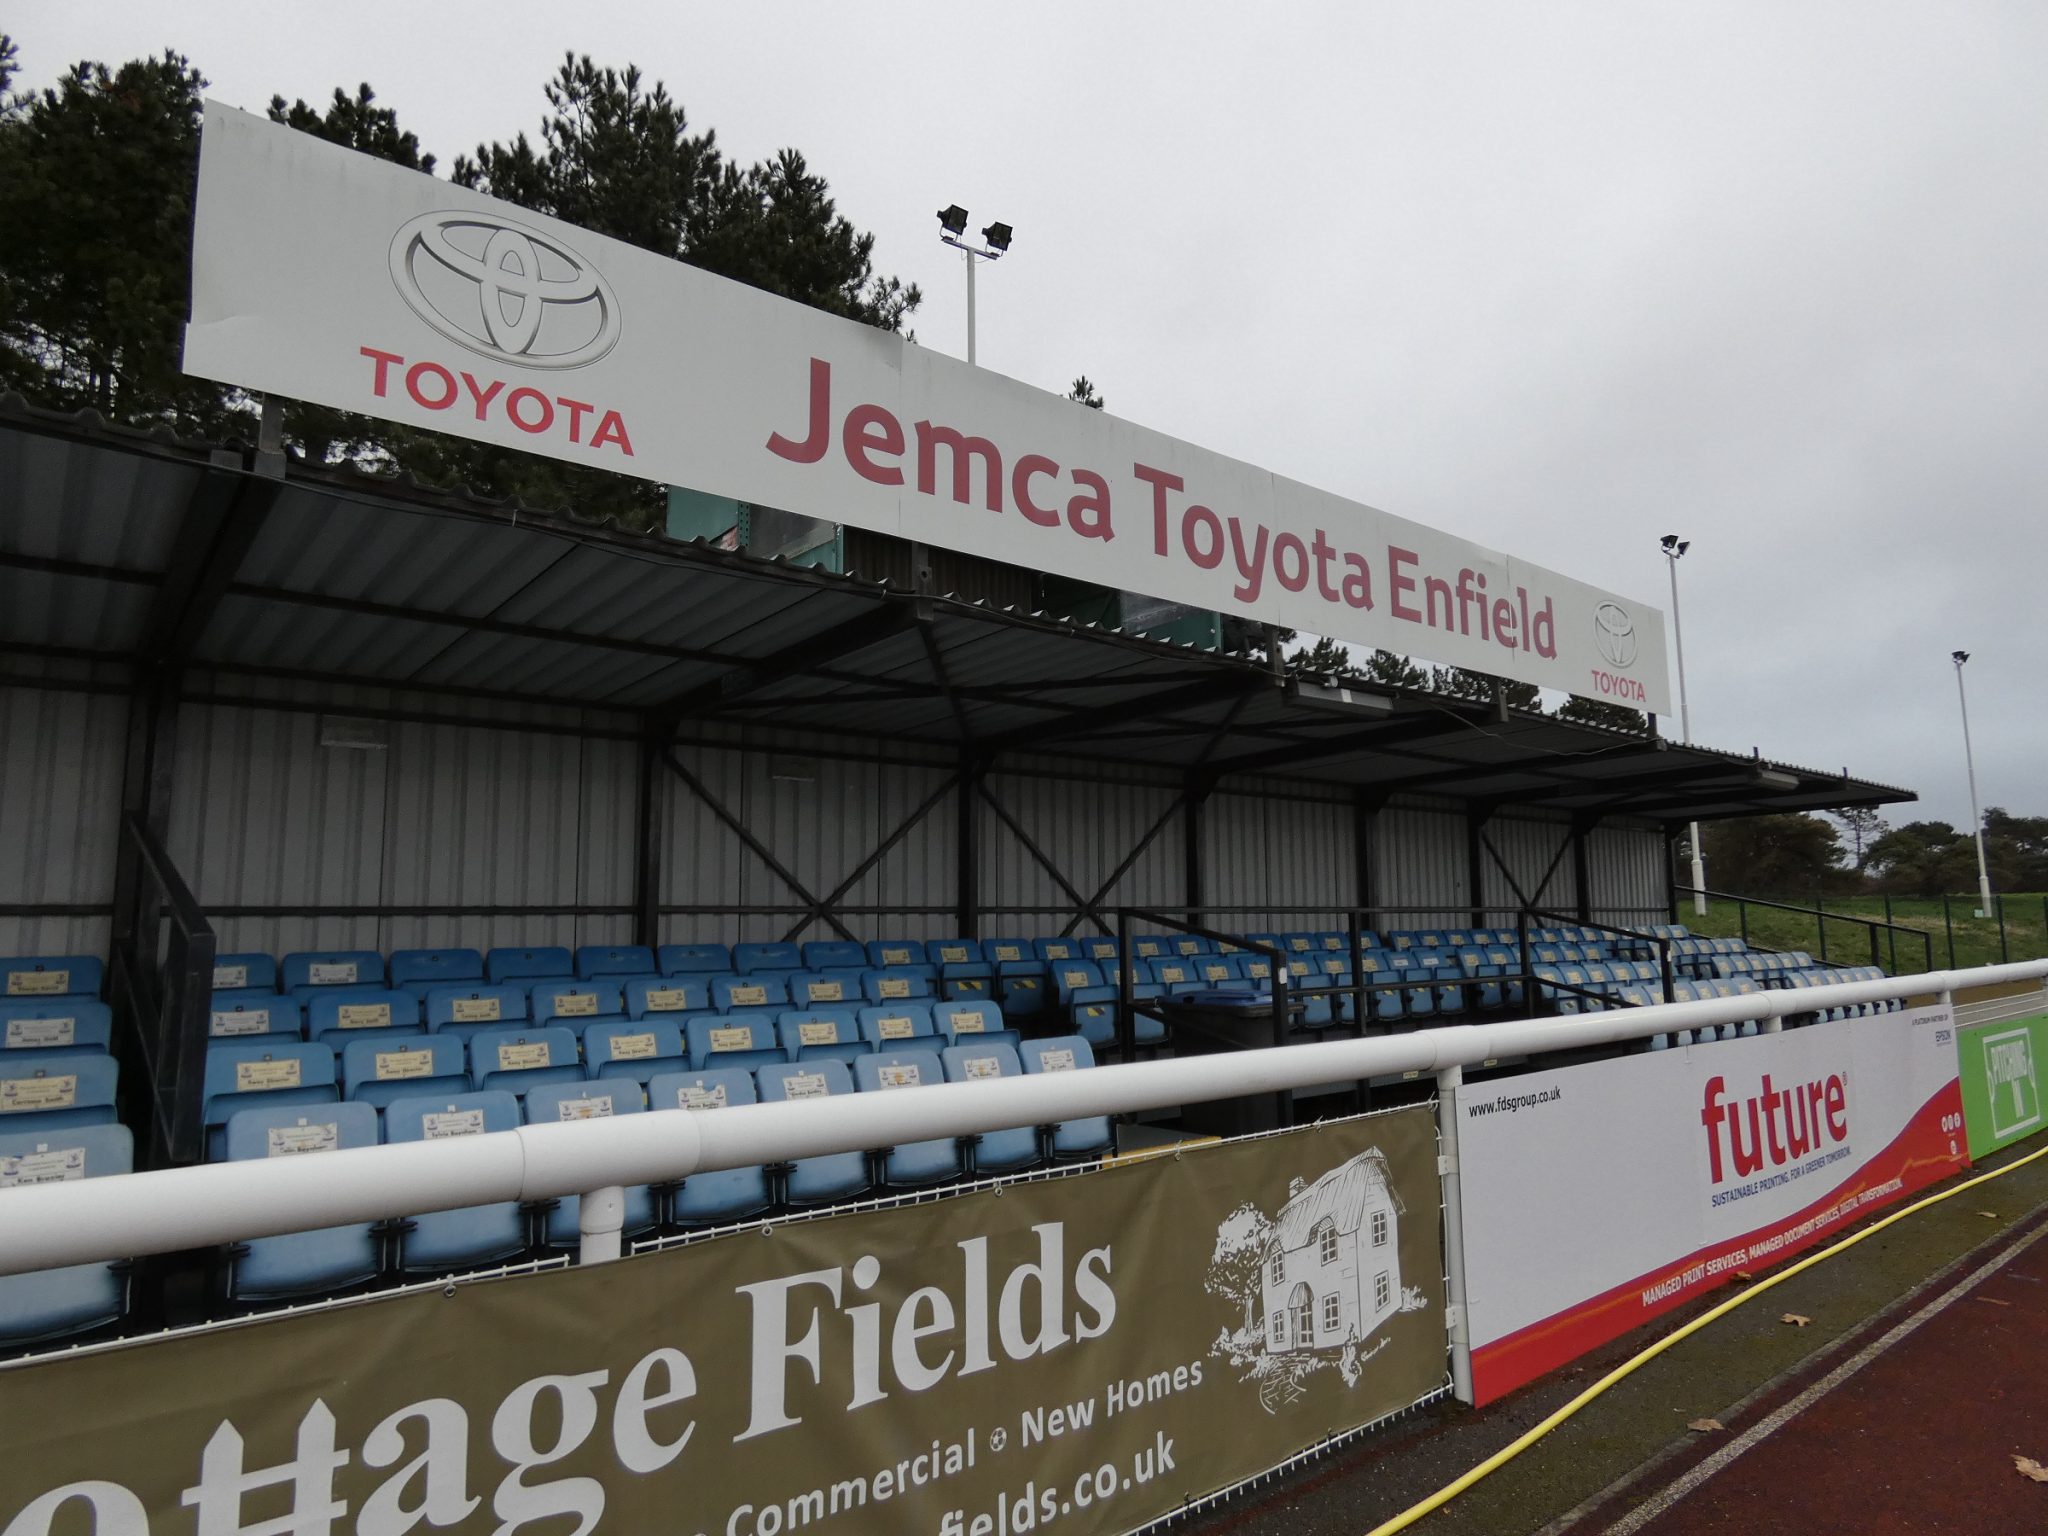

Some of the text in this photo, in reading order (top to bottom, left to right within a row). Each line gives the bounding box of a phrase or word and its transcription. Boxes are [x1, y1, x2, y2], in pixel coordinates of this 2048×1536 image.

[360, 346, 634, 457] TOYOTA
[765, 356, 1558, 661] Jemca Toyota Enfield
[1592, 669, 1647, 703] TOYOTA
[1468, 1085, 1562, 1118] www.fdsgroup.co.uk
[1700, 1073, 1847, 1184] future
[1711, 1181, 1759, 1208] SUSTAINABLE
[1642, 1275, 1682, 1308] MANAGED
[1682, 1264, 1705, 1290] PRINT
[1706, 1248, 1749, 1277] SERVICES,
[1749, 1233, 1784, 1260] MANAGED
[733, 1221, 1117, 1444] Fields
[727, 1359, 1203, 1536] Commercial New Homes
